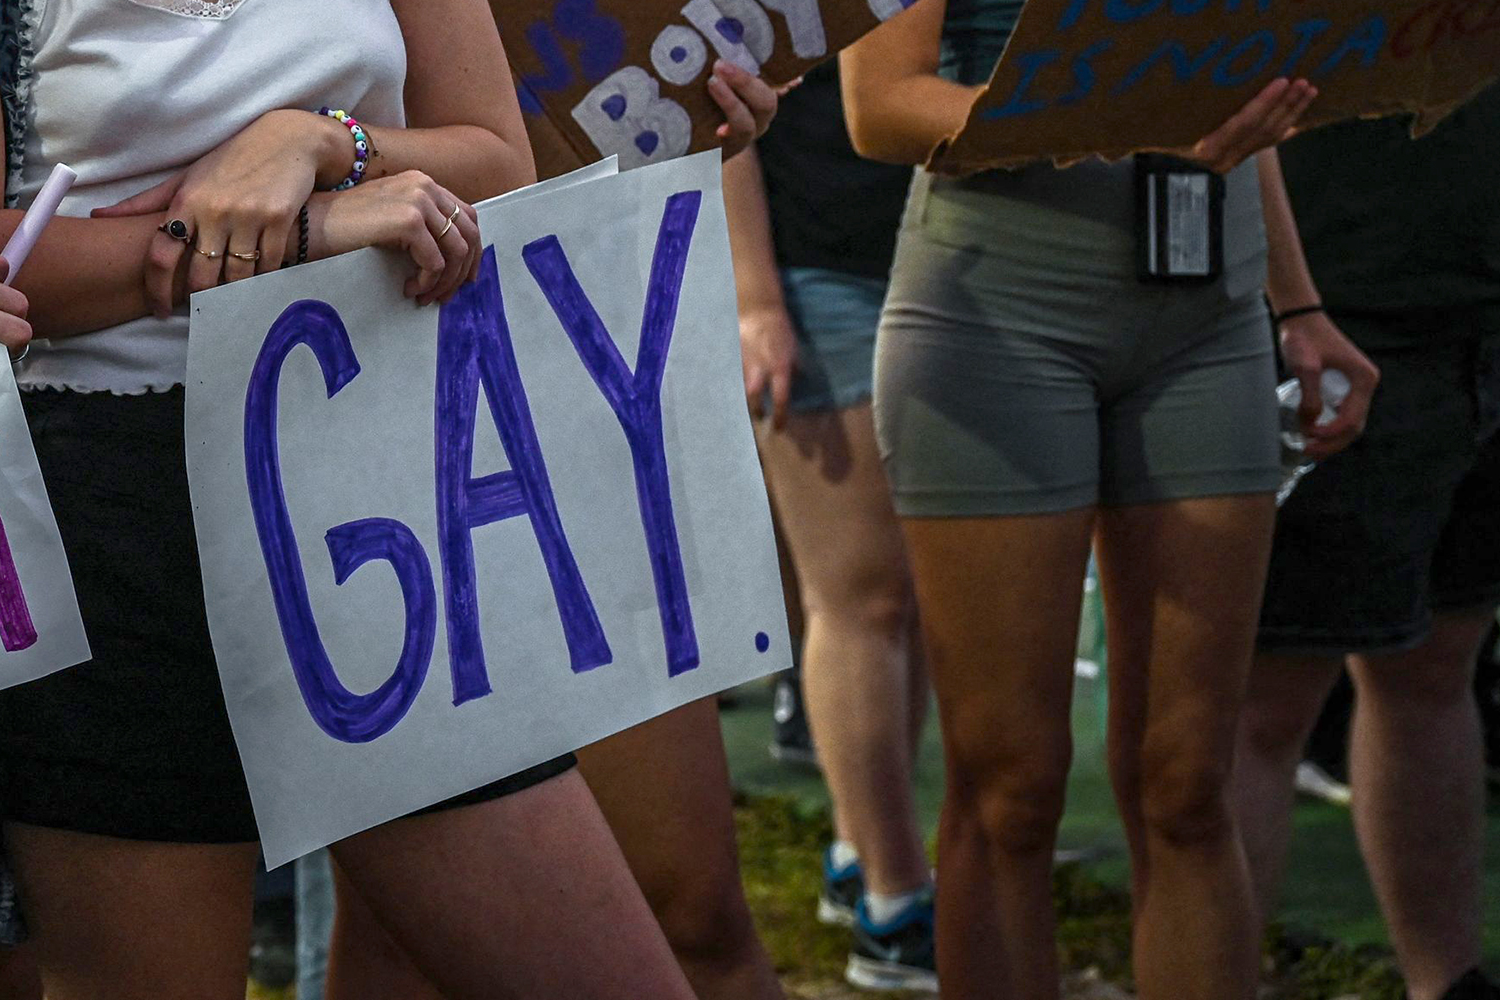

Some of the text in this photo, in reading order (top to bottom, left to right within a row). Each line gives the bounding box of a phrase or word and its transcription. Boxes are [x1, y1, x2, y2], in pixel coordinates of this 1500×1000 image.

[980, 38, 1114, 122] IS
[1110, 19, 1330, 96] NOT
[1315, 14, 1389, 78] A
[243, 189, 770, 743] GAY.
